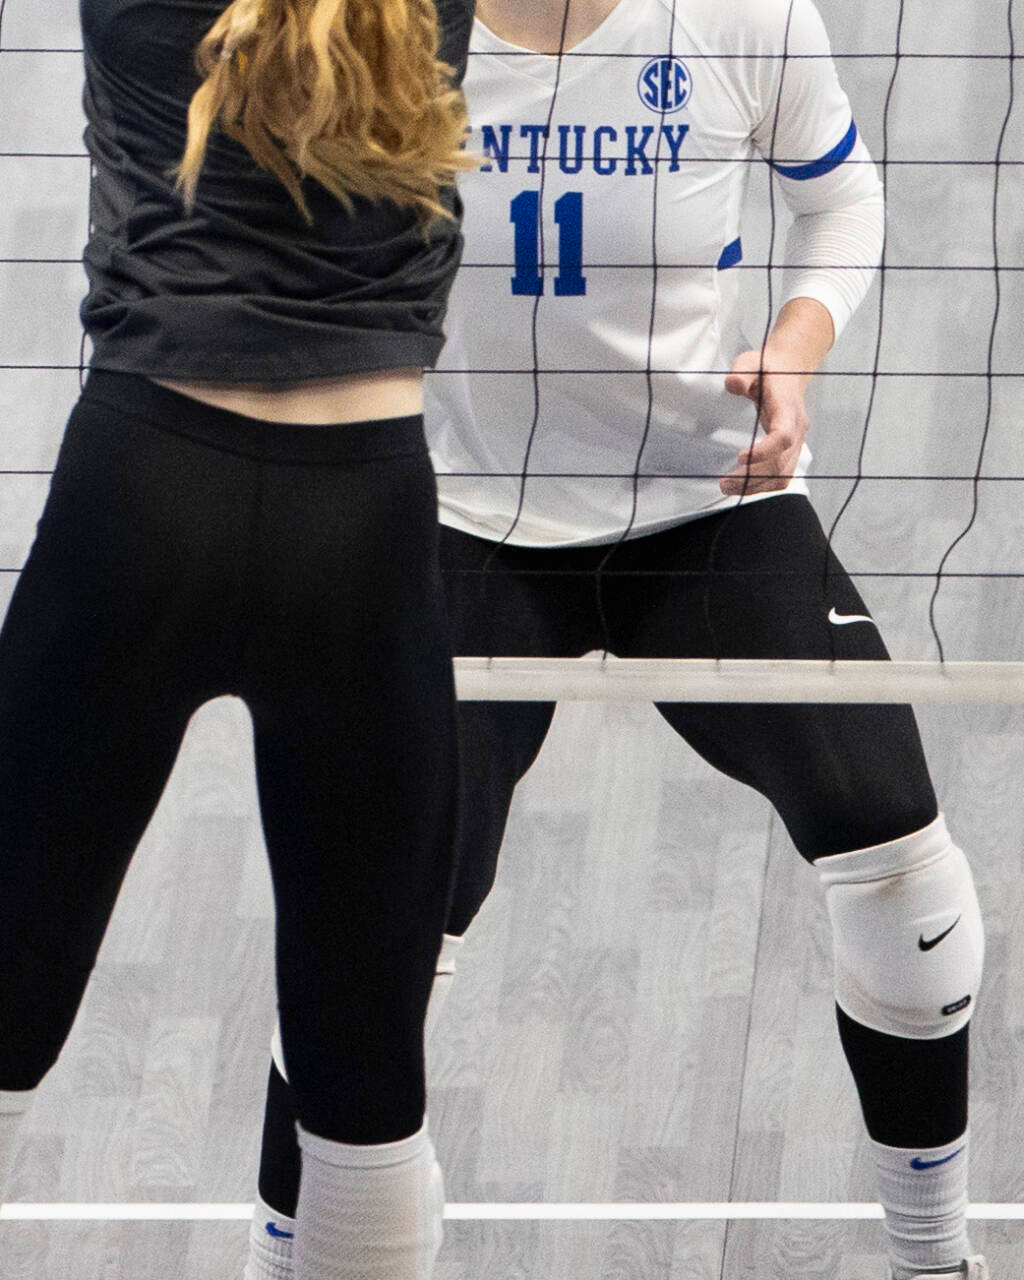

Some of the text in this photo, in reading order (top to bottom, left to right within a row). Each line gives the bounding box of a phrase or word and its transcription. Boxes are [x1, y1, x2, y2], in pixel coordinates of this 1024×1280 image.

[643, 60, 687, 110] SEC
[463, 124, 690, 175] NTUCKY
[510, 190, 586, 296] 11
